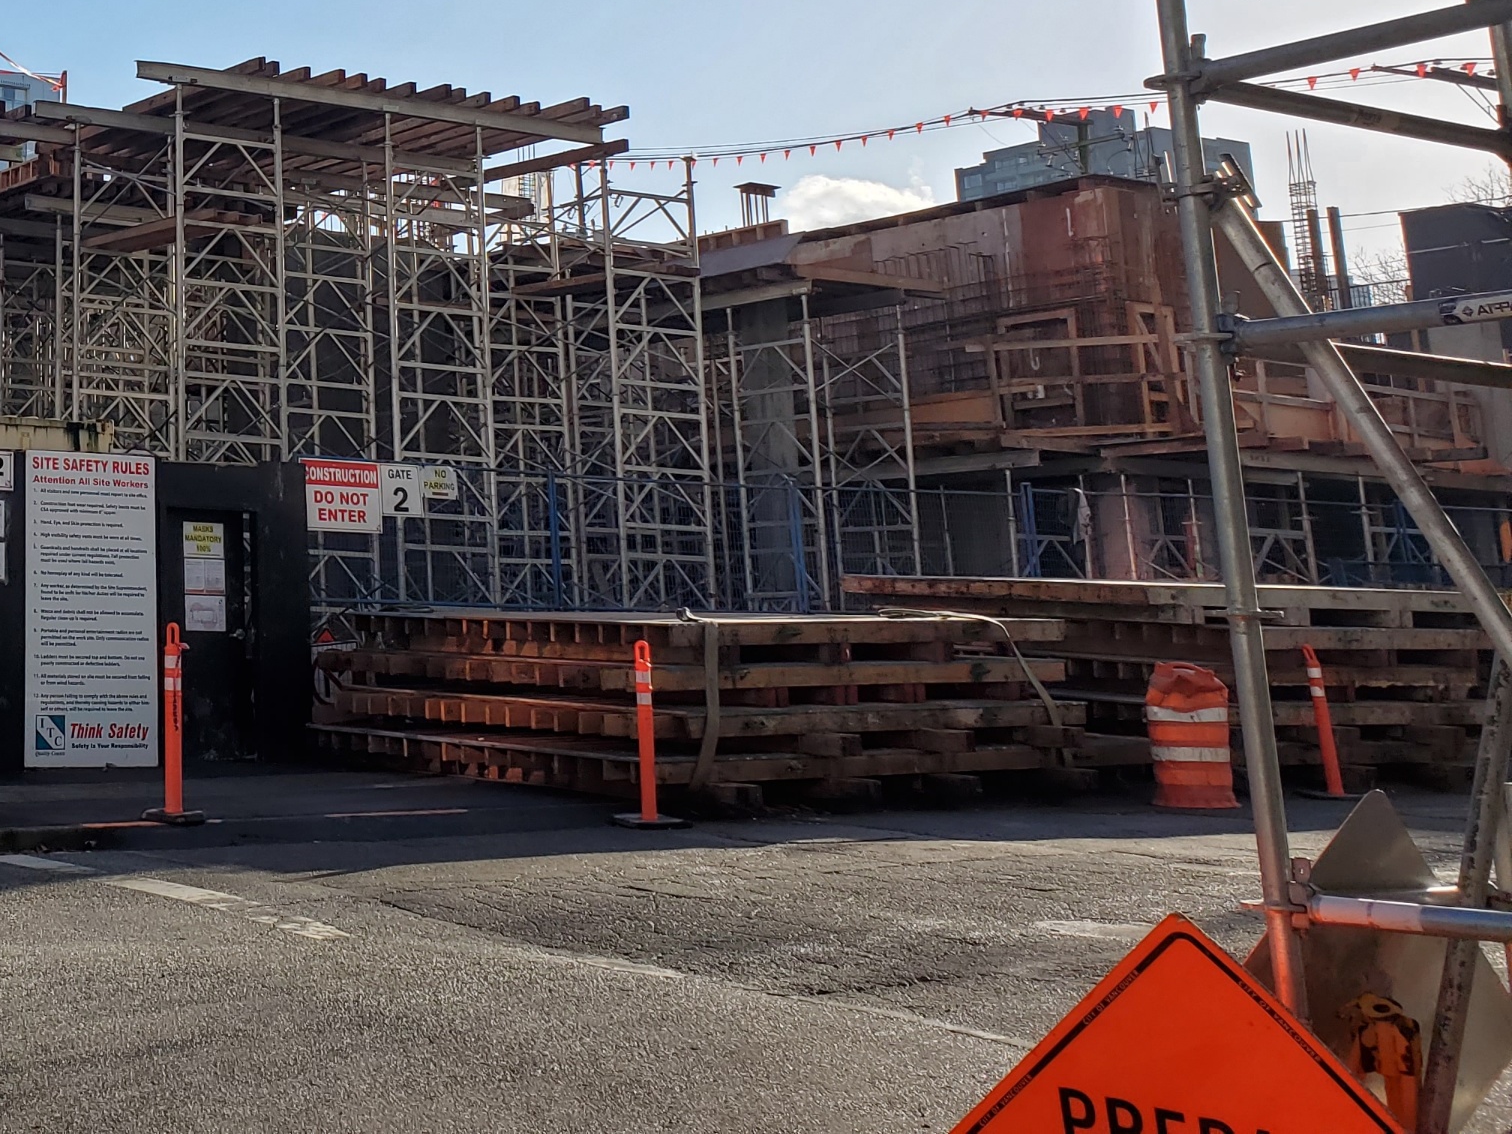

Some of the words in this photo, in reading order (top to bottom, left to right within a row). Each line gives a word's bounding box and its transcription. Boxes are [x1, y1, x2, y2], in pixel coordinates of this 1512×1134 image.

[32, 456, 59, 470] SITE
[63, 458, 109, 473] SAFETY
[112, 461, 150, 476] RULES
[434, 469, 447, 478] NO
[32, 475, 76, 485] Attention
[78, 477, 91, 485] All
[92, 478, 110, 487] Site
[112, 479, 149, 489] Workers
[305, 466, 377, 485] CONSTRUCTION
[388, 469, 412, 480] GATE
[423, 481, 455, 491] PARKING
[313, 490, 334, 505] DO
[339, 492, 369, 506] NOT
[393, 487, 410, 513] 2
[317, 508, 367, 524] ENTER
[185, 535, 222, 543] MANDATORY
[40, 718, 62, 746] ITC
[71, 723, 103, 739] Think
[108, 723, 149, 741] Safety
[1105, 969, 1139, 1003] VANCOUVER
